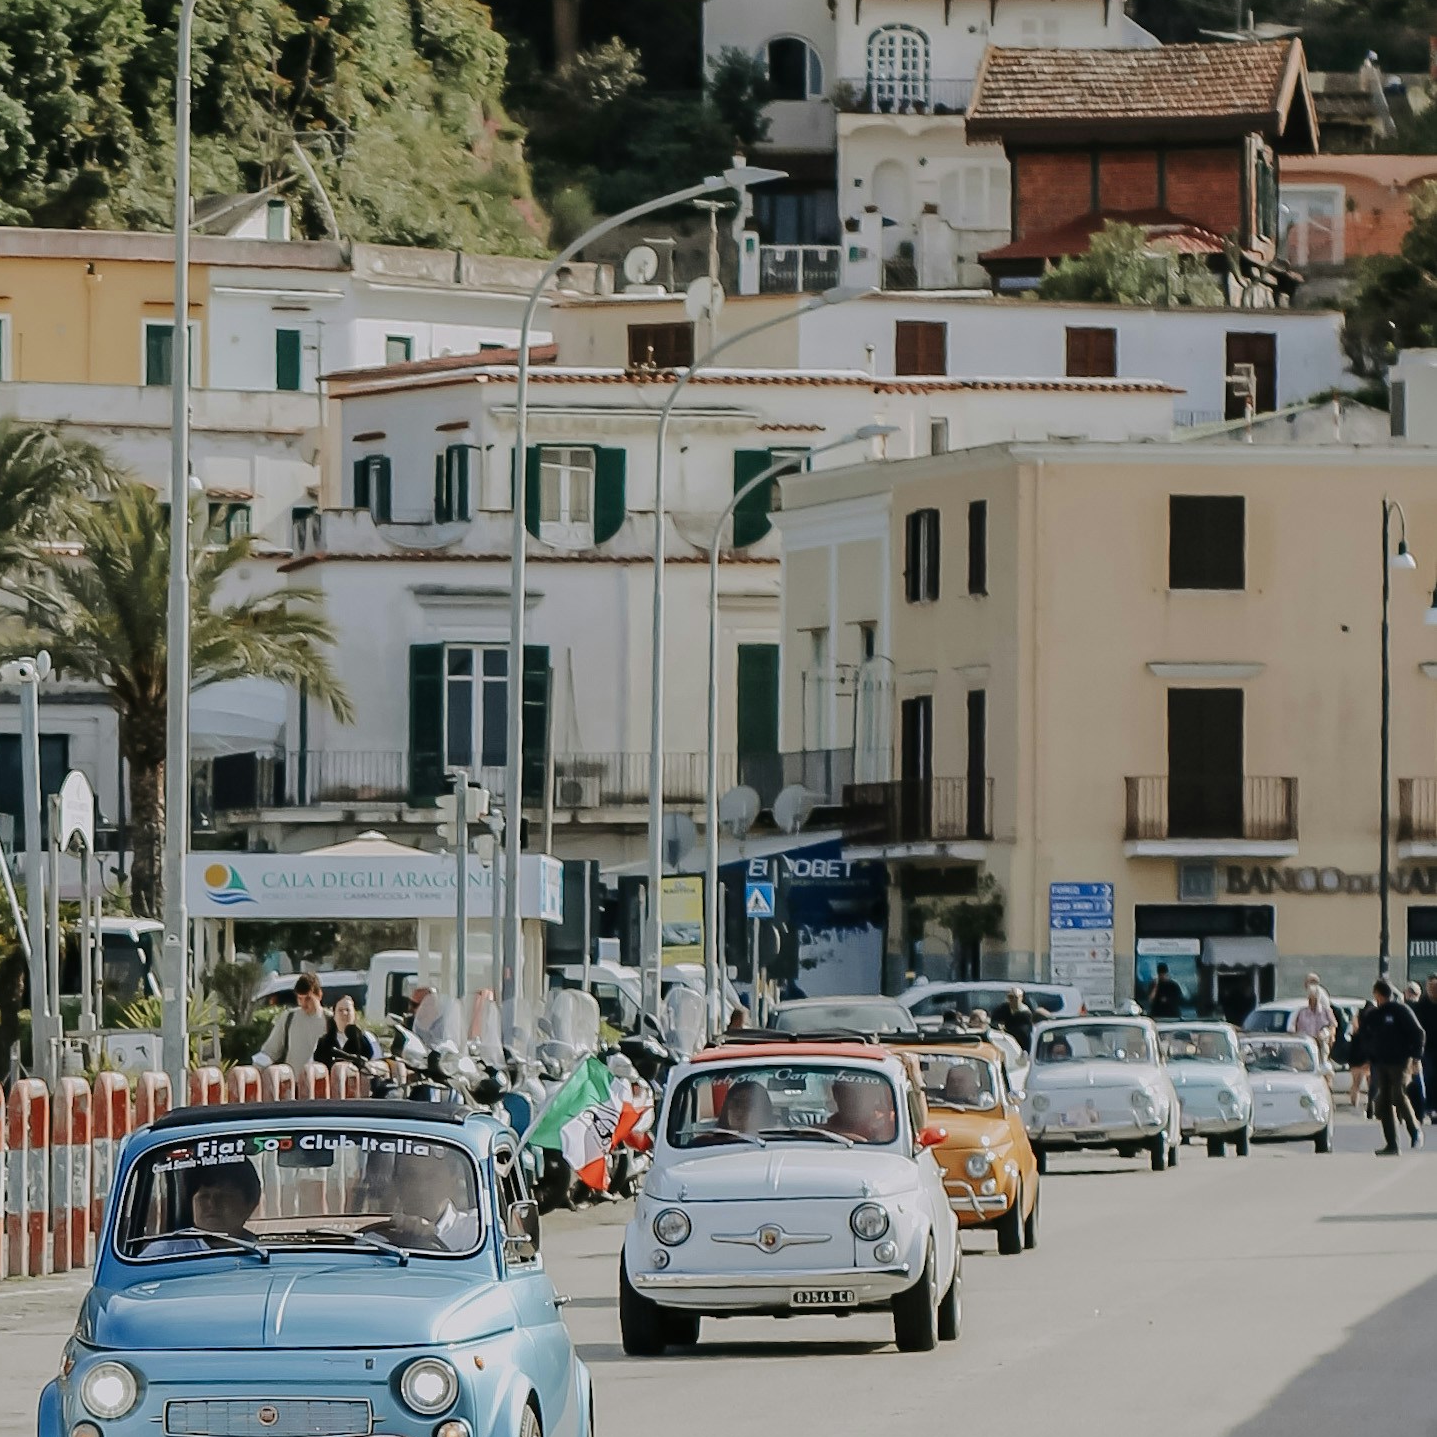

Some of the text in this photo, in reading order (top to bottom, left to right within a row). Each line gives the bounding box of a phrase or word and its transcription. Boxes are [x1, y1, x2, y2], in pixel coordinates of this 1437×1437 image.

[748, 858, 857, 878] EOBET
[262, 871, 314, 889] CALA
[322, 871, 384, 889] DEGLI
[1226, 864, 1344, 895] BANCO
[197, 1134, 431, 1157] Fiat 500 Club Italia
